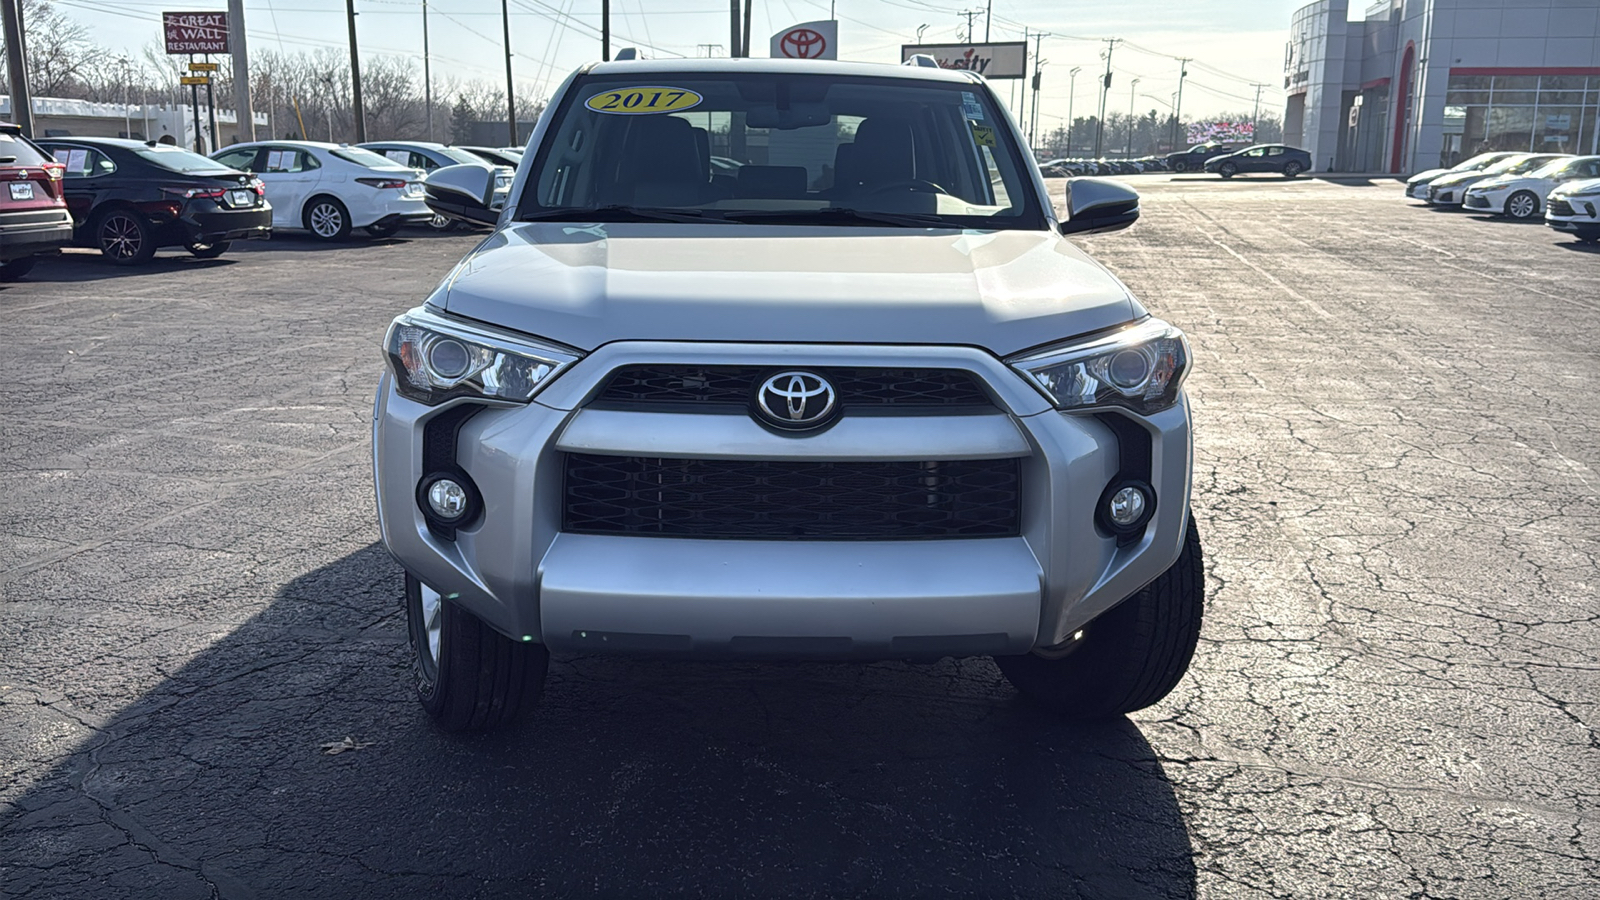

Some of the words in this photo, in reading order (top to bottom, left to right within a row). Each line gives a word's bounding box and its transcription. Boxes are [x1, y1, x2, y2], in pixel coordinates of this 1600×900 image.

[180, 15, 222, 27] GREAT
[180, 28, 222, 39] WALL
[601, 92, 686, 109] 2017
